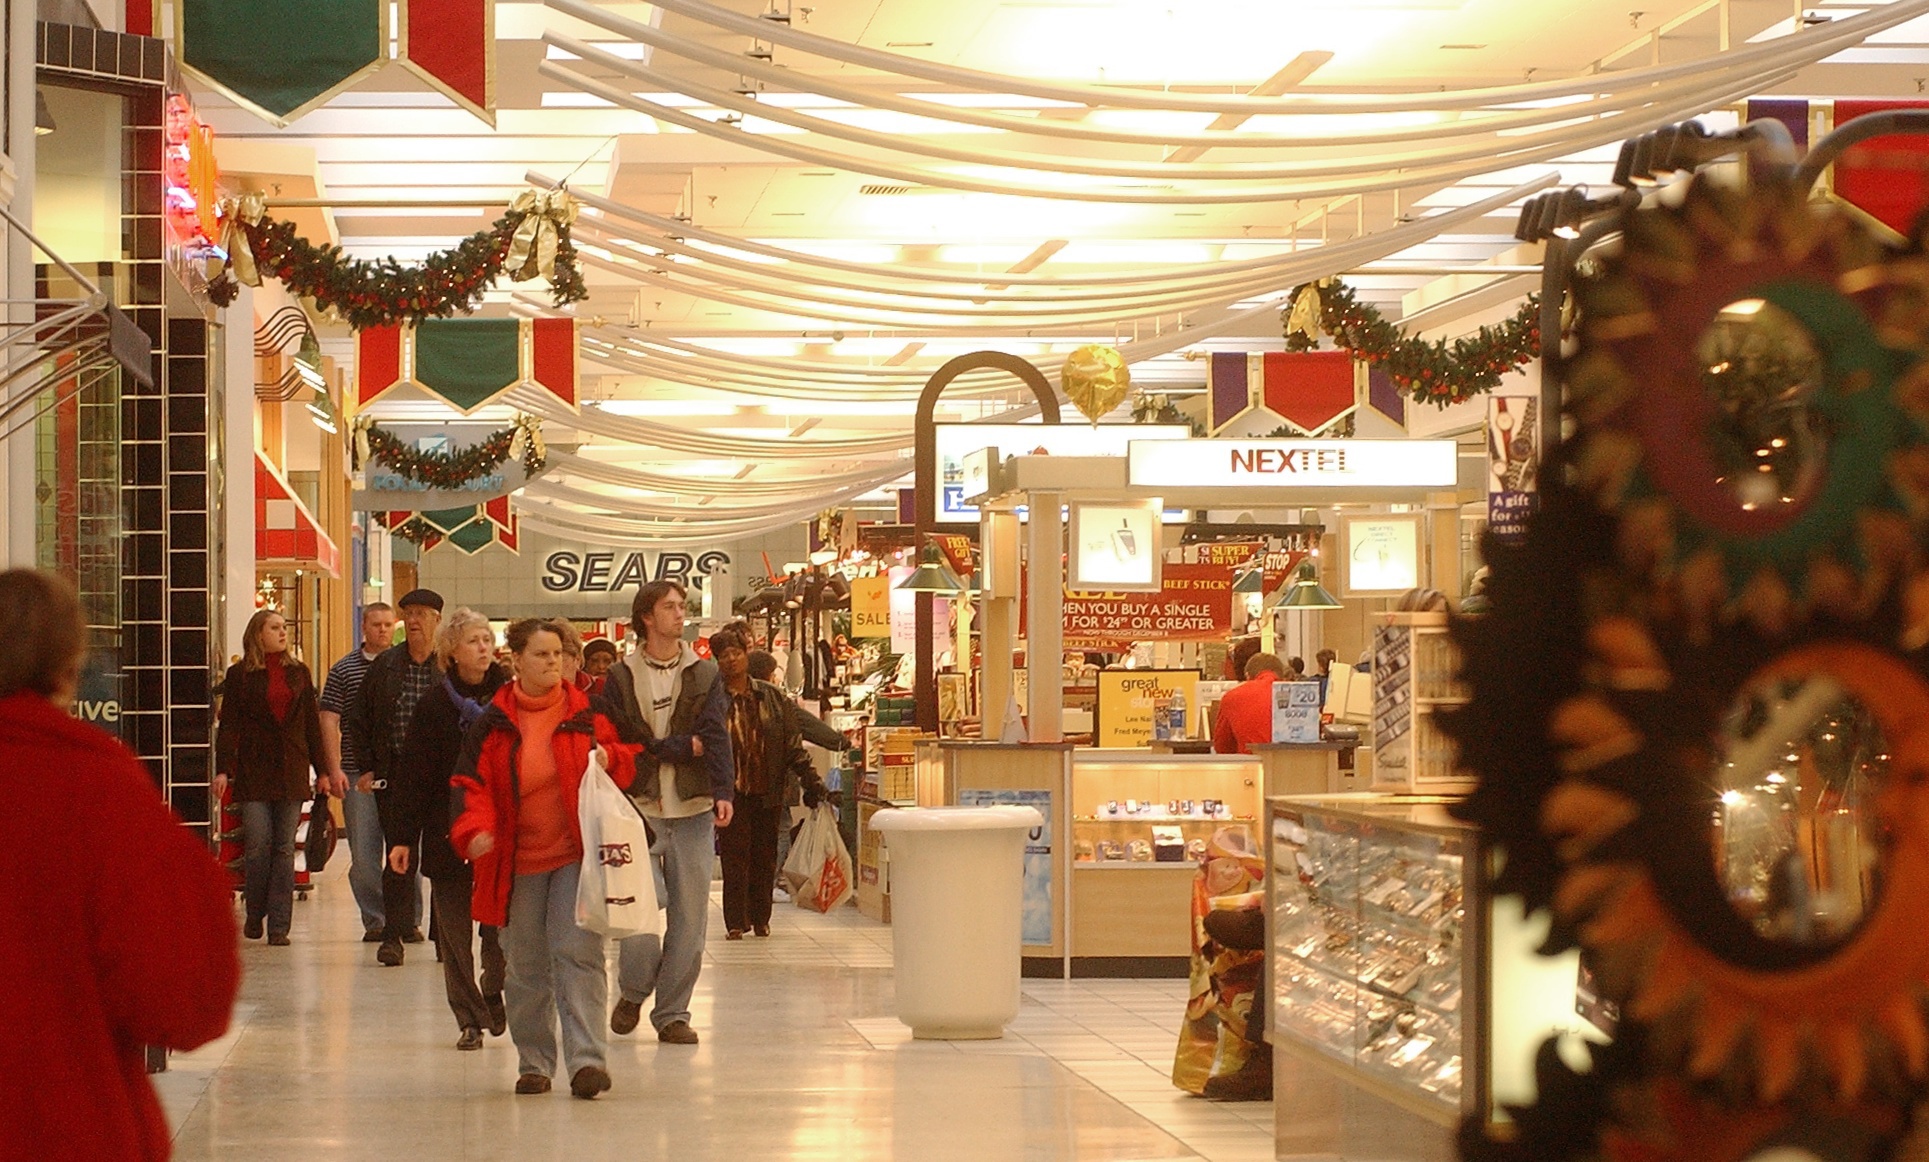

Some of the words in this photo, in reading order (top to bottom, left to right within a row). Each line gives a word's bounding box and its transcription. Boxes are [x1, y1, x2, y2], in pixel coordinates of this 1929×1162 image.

[1231, 449, 1355, 473] NEXTEL
[1494, 495, 1504, 506] A
[1505, 494, 1529, 508] gift
[1491, 509, 1511, 521] for
[946, 537, 970, 549] FREE
[1211, 545, 1250, 556] SUPER
[1265, 553, 1290, 570] STOP
[541, 551, 732, 592] SEARS
[1163, 580, 1190, 589] BEEF
[1062, 602, 1086, 615] HEN
[1088, 602, 1118, 616] YOU
[1121, 603, 1149, 616] BUY
[1150, 605, 1161, 616] A
[1164, 604, 1211, 617] SINGLE
[856, 613, 890, 625] SALE
[1072, 616, 1099, 628] FOR
[1131, 617, 1152, 629] OR
[1155, 617, 1215, 630] GREATER
[1121, 676, 1159, 692] great
[1142, 688, 1174, 699] new
[1132, 728, 1151, 736] Meye
